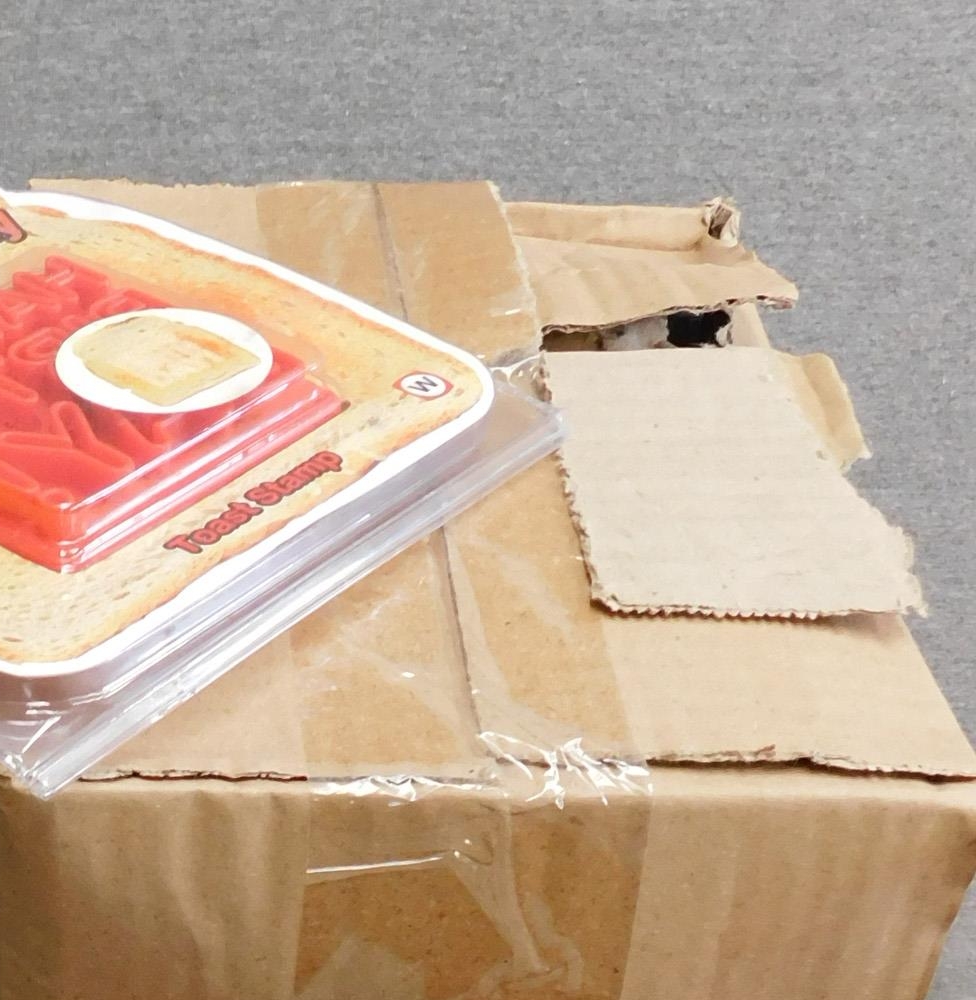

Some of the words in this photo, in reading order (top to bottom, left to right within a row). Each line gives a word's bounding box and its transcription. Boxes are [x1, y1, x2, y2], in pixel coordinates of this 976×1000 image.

[408, 376, 438, 394] W
[163, 501, 264, 554] Toast
[244, 450, 343, 506] Stamp
